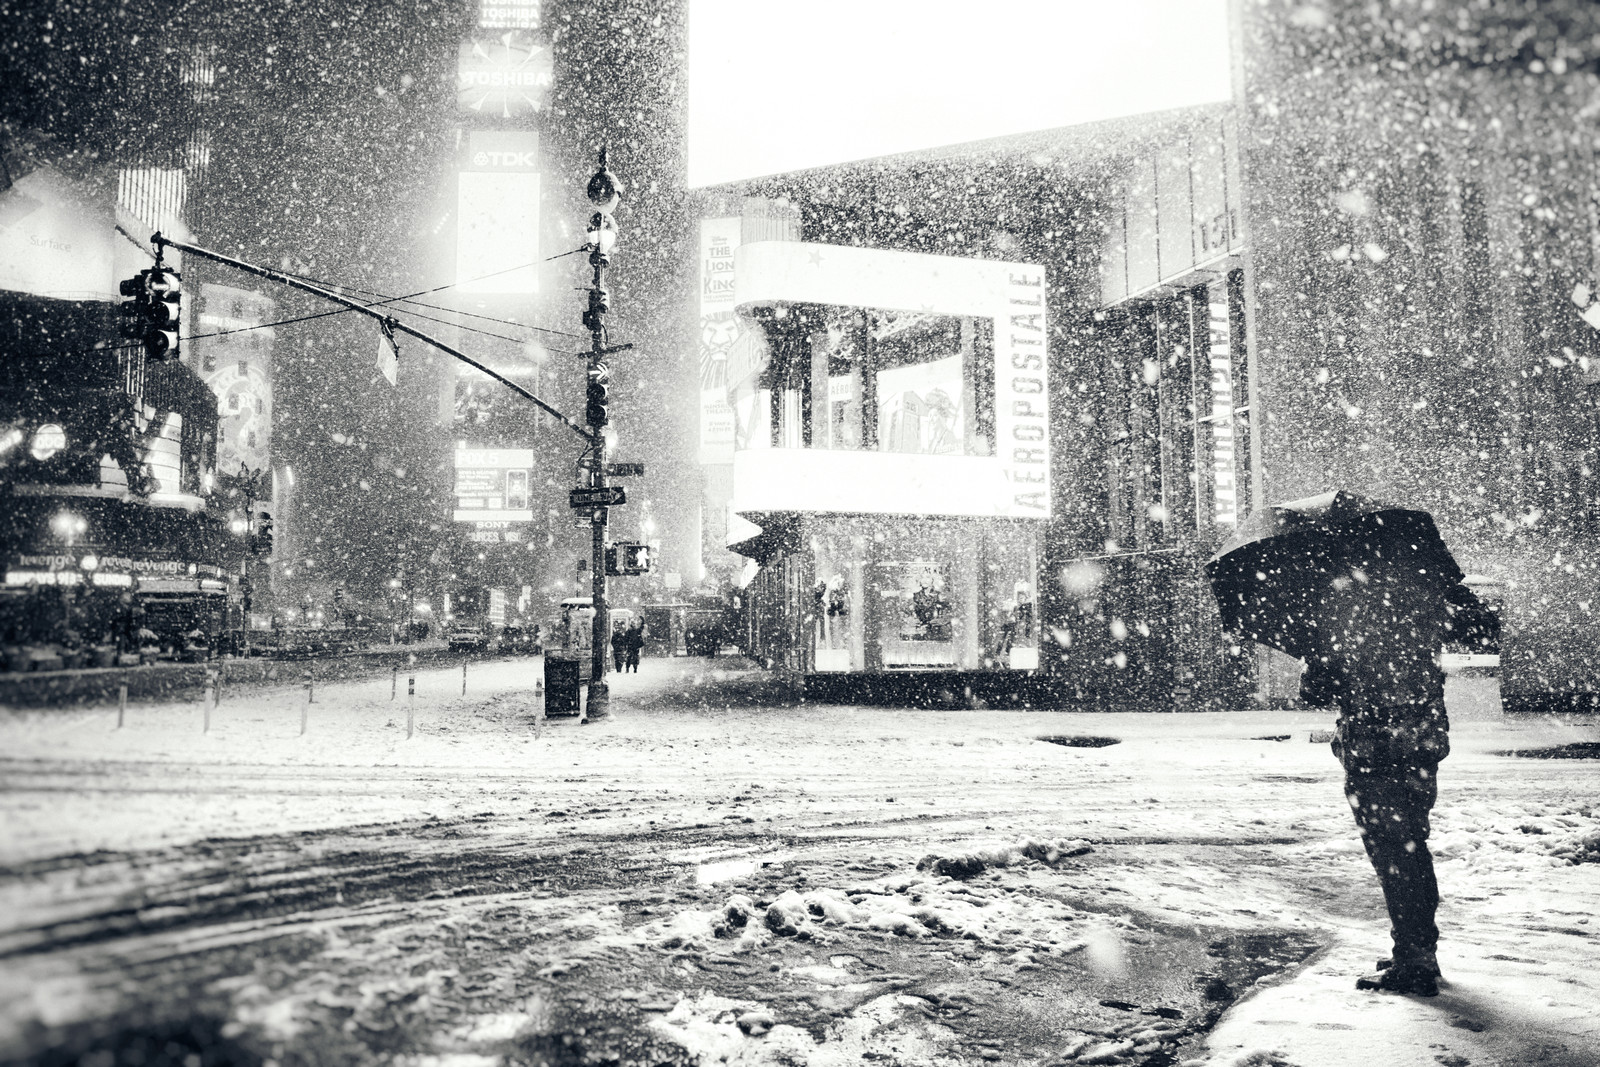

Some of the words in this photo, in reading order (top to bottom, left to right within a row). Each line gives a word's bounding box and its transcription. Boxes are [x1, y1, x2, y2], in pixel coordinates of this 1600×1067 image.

[482, 8, 540, 19] TOSHIBA
[464, 71, 549, 86] TOSHIBA
[488, 152, 535, 166] TDK
[30, 234, 73, 253] Surface
[708, 246, 731, 257] THE
[457, 452, 487, 466] FOX
[488, 452, 499, 465] 5
[576, 493, 593, 502] ONE
[600, 492, 616, 502] WAY
[132, 559, 186, 572] revenge
